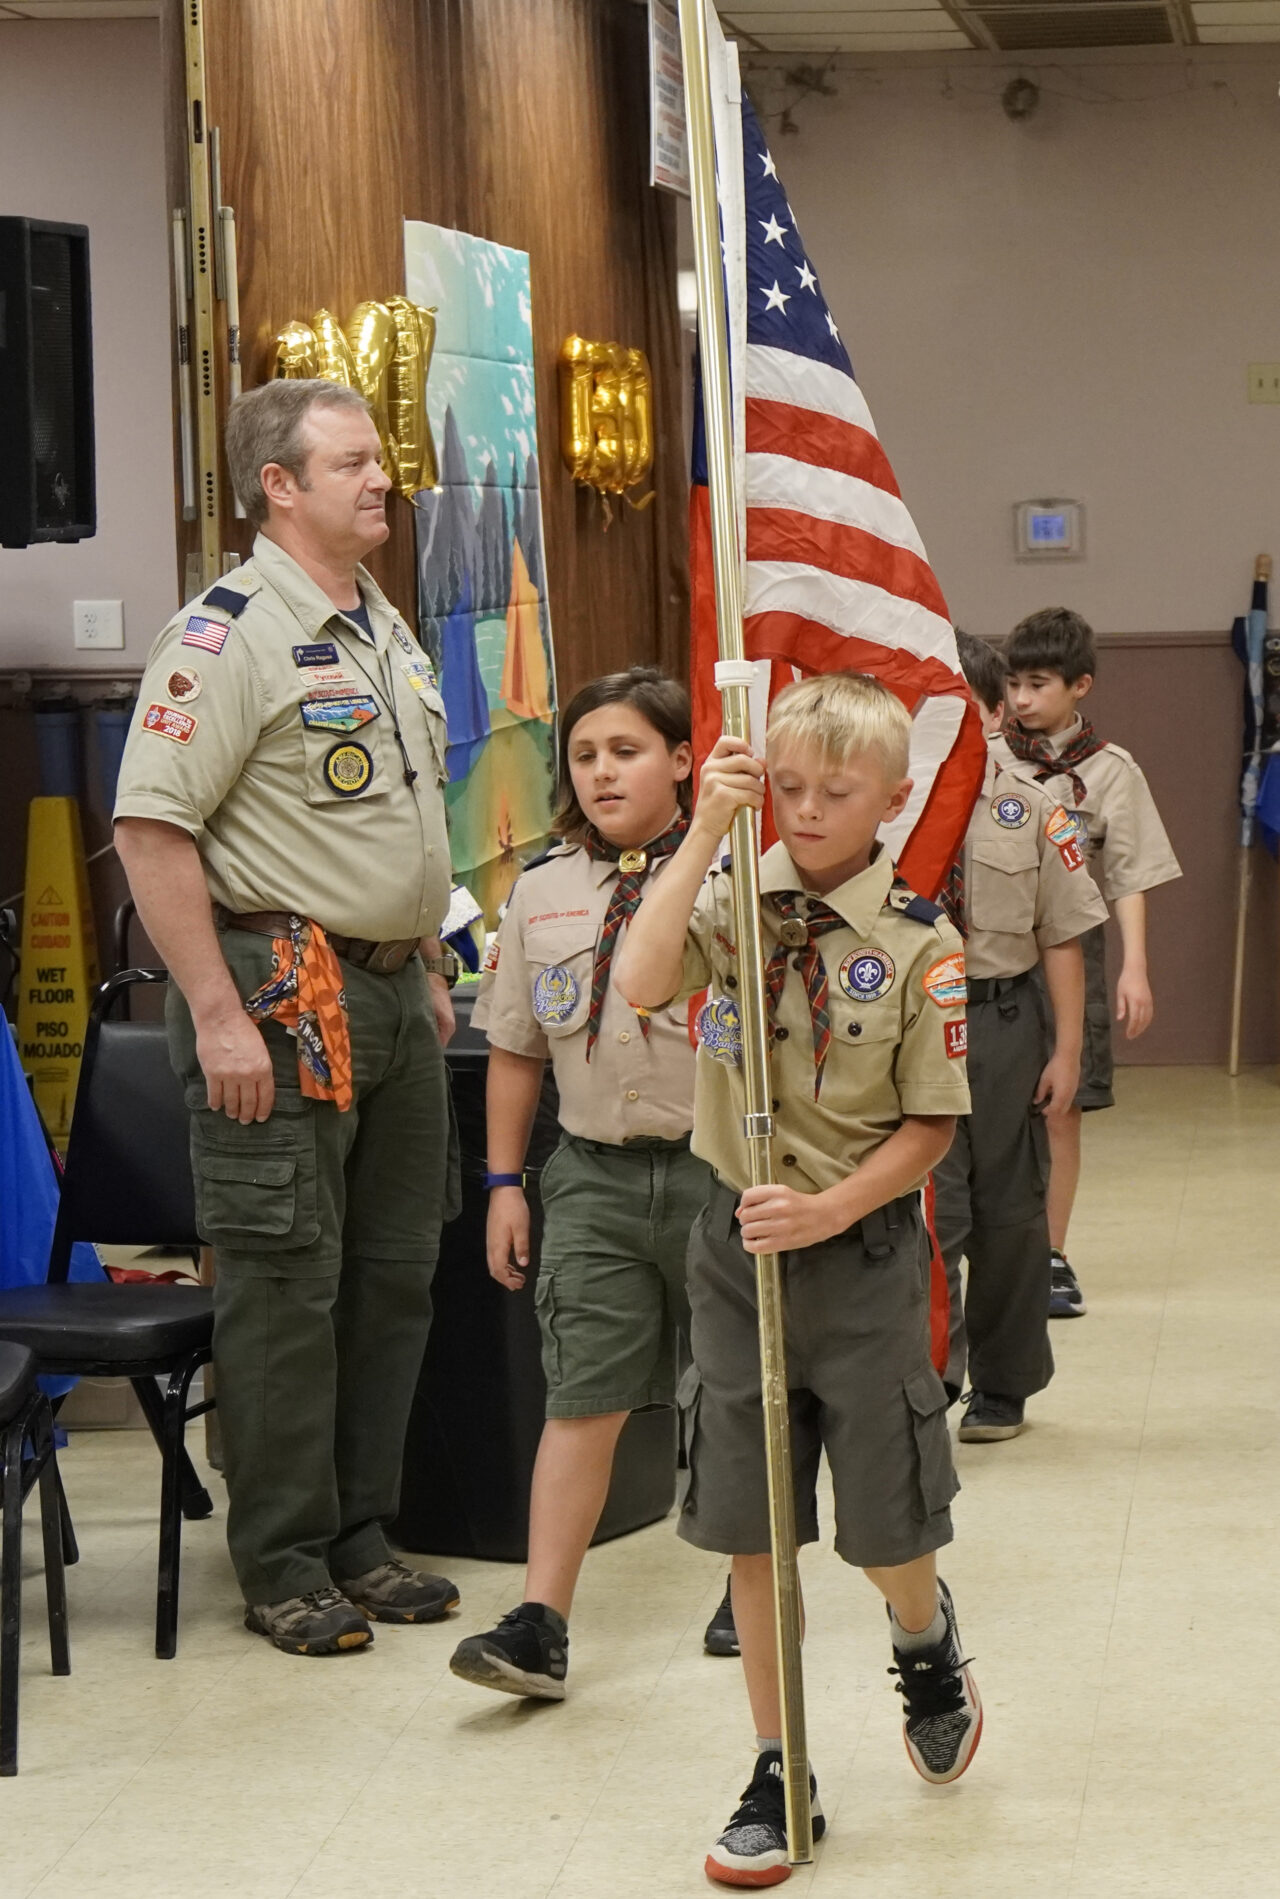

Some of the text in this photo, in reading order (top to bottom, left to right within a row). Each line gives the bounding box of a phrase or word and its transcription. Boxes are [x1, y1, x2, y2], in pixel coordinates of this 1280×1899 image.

[163, 725, 182, 737] 2018
[30, 912, 71, 928] CAUTION
[565, 909, 590, 918] AMERICA
[30, 934, 72, 949] CUIDADO
[36, 967, 67, 983] WET
[29, 988, 75, 1004] FLOOR
[36, 1021, 69, 1038] PISO
[23, 1043, 82, 1059] MOJADO
